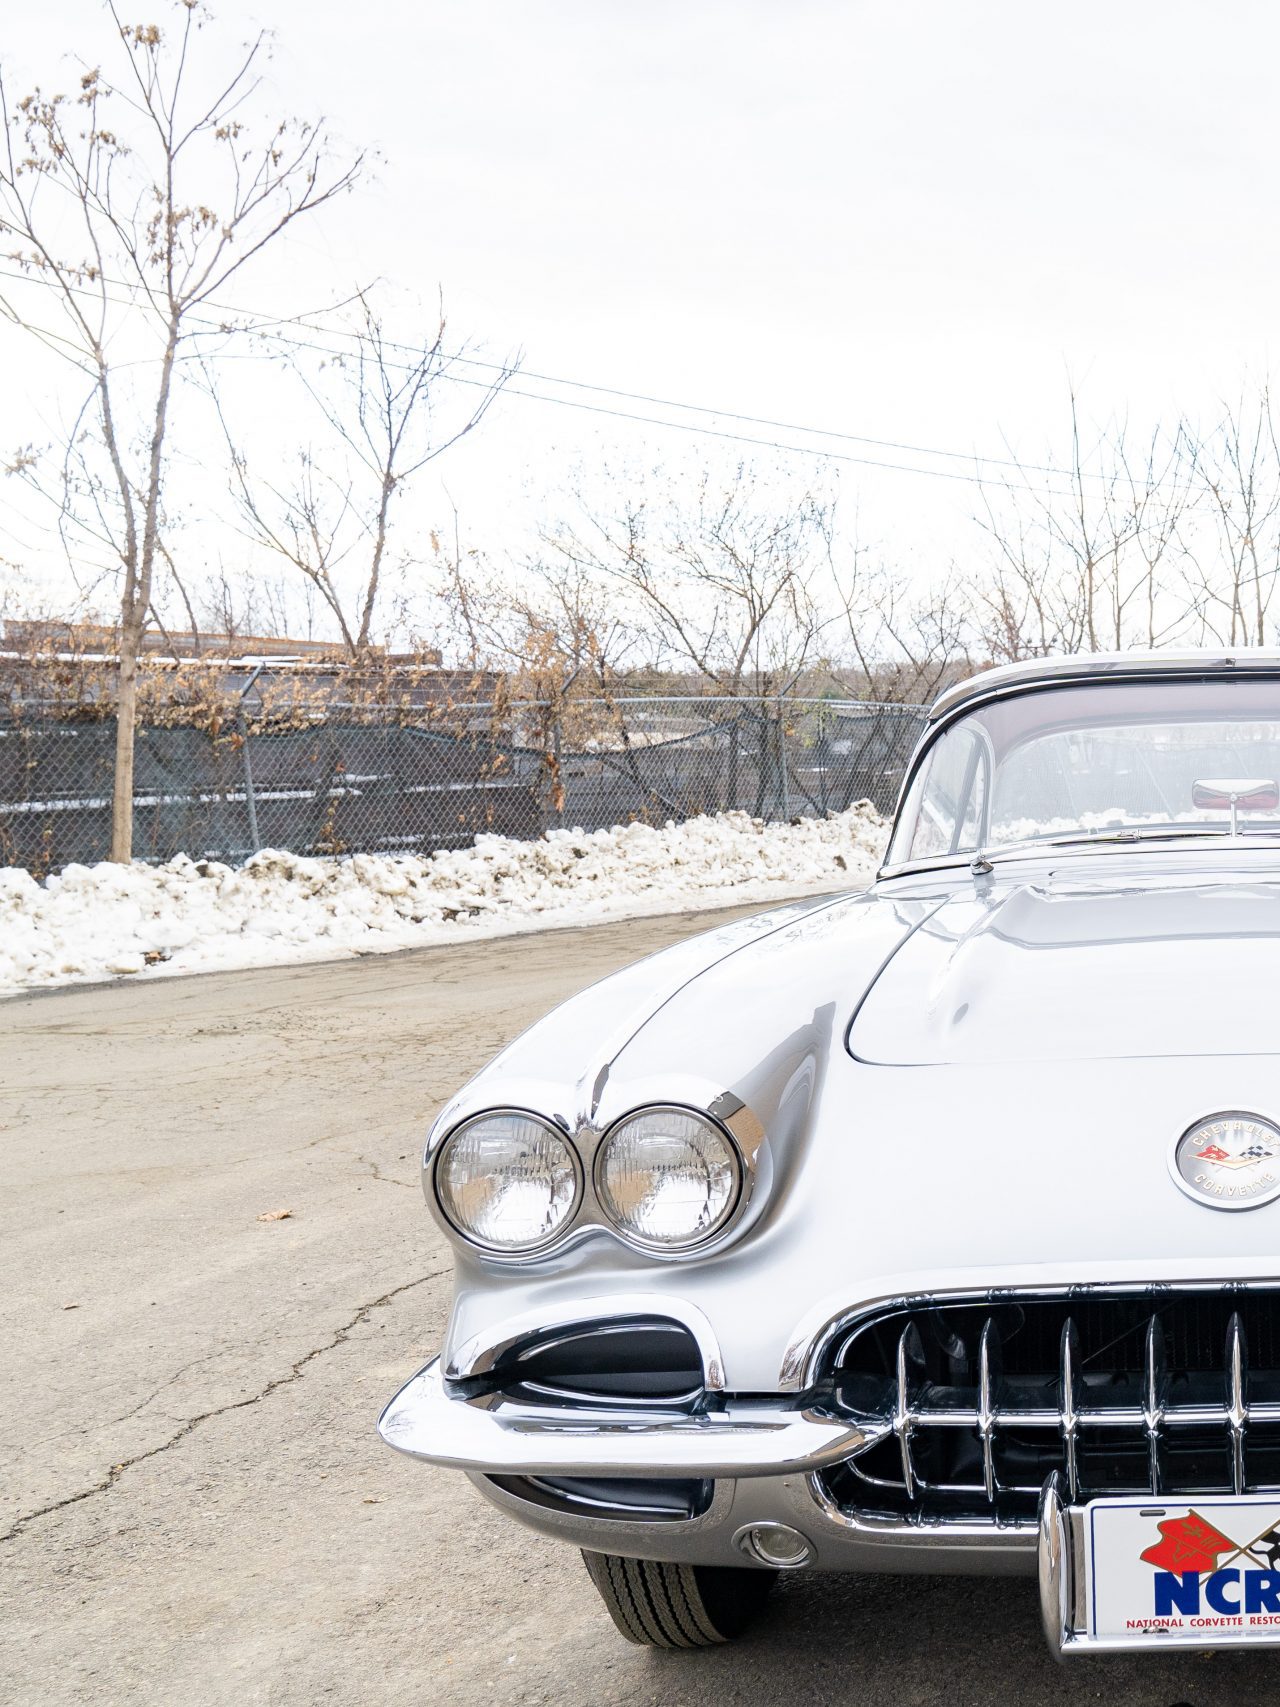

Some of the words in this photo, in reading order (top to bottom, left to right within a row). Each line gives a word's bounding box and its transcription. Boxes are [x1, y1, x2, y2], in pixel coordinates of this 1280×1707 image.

[1192, 1120, 1280, 1147] CHEVROLET
[1194, 1173, 1275, 1197] CORVETTE
[1126, 1618, 1184, 1628] NATIONAL
[1190, 1617, 1243, 1627] CORVETTE
